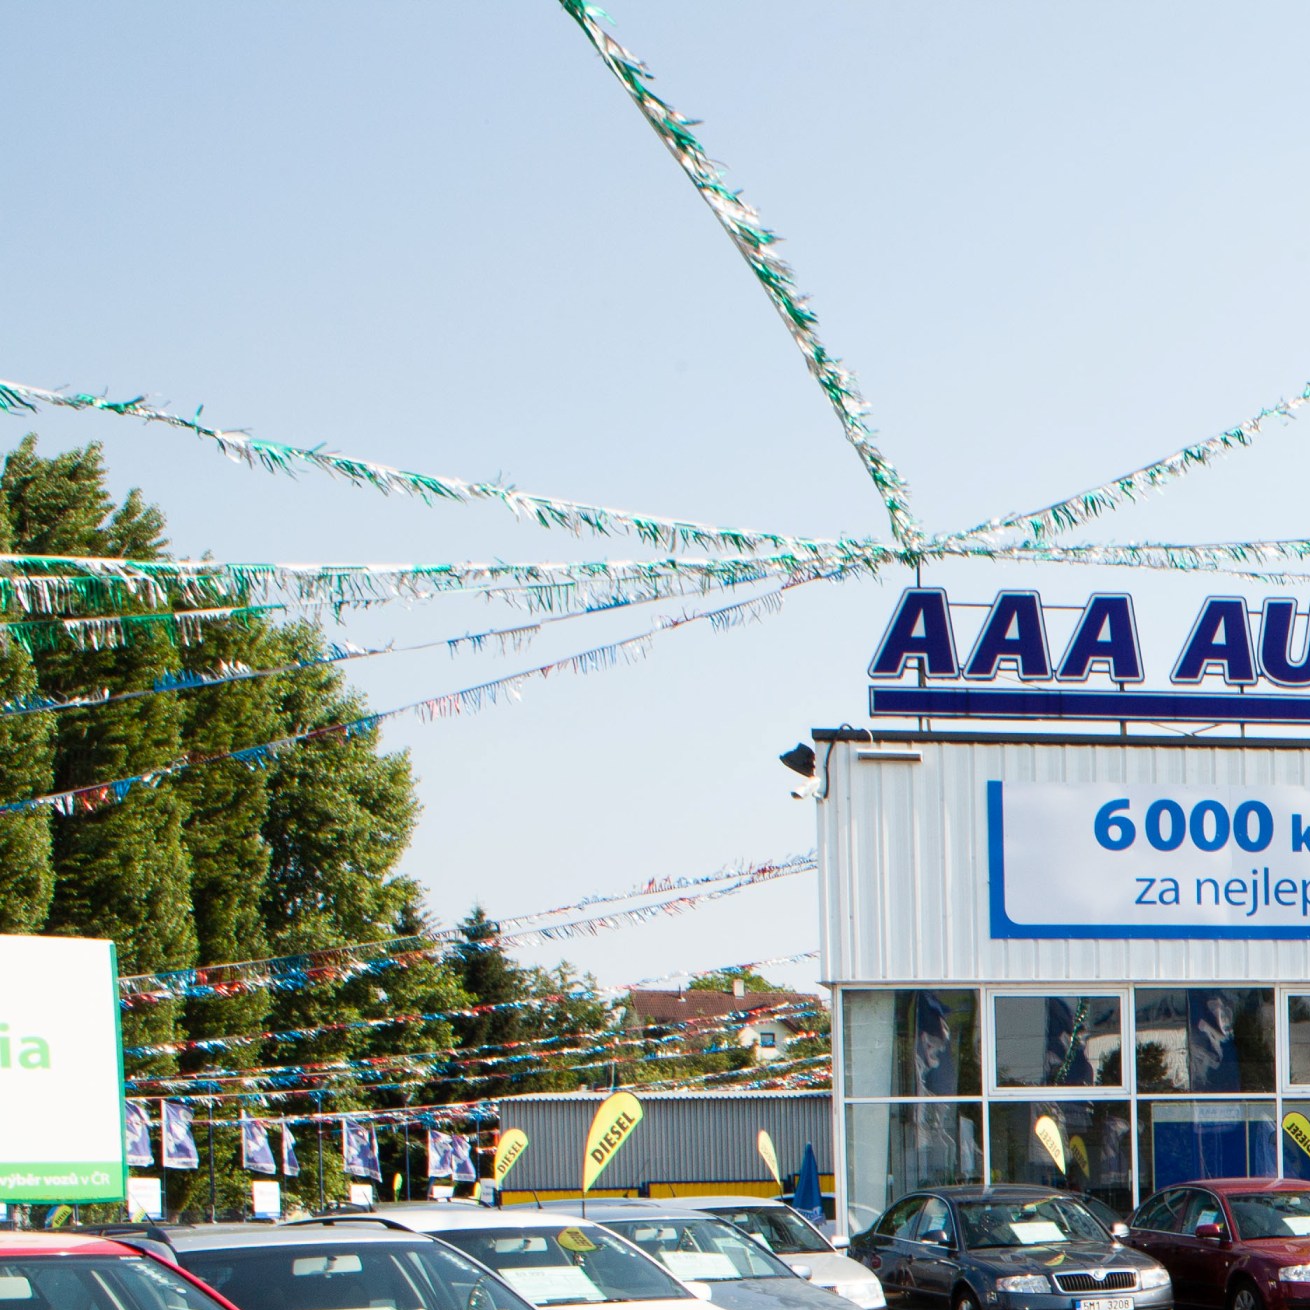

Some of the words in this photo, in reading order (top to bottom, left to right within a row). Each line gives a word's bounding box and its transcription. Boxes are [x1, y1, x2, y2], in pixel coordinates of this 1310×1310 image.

[867, 586, 1145, 683] AAA
[1135, 876, 1180, 907] za
[496, 1140, 524, 1174] DIESEL
[591, 1111, 635, 1165] DIESEL
